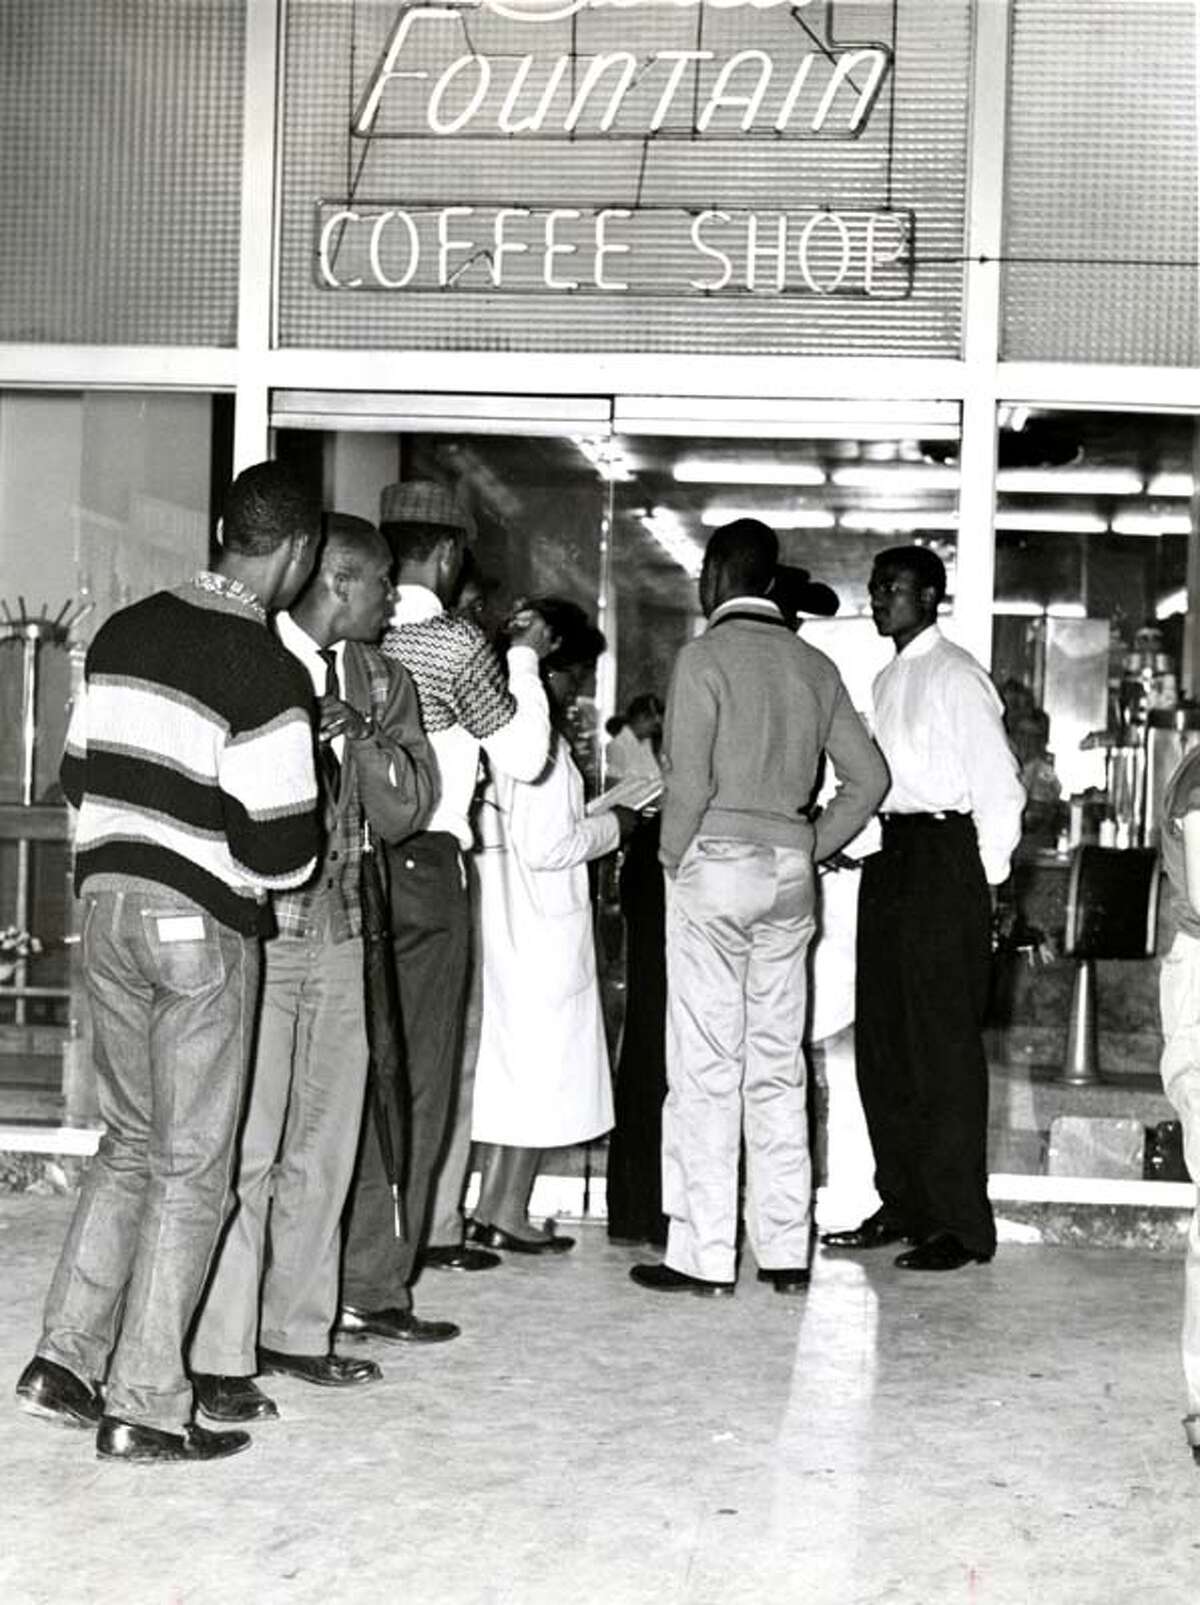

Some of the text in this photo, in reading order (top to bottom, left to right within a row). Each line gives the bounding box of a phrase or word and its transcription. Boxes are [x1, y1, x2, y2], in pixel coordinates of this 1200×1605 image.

[358, 8, 886, 133] FOUNTAIN
[319, 207, 907, 294] COFFEE SHOP
